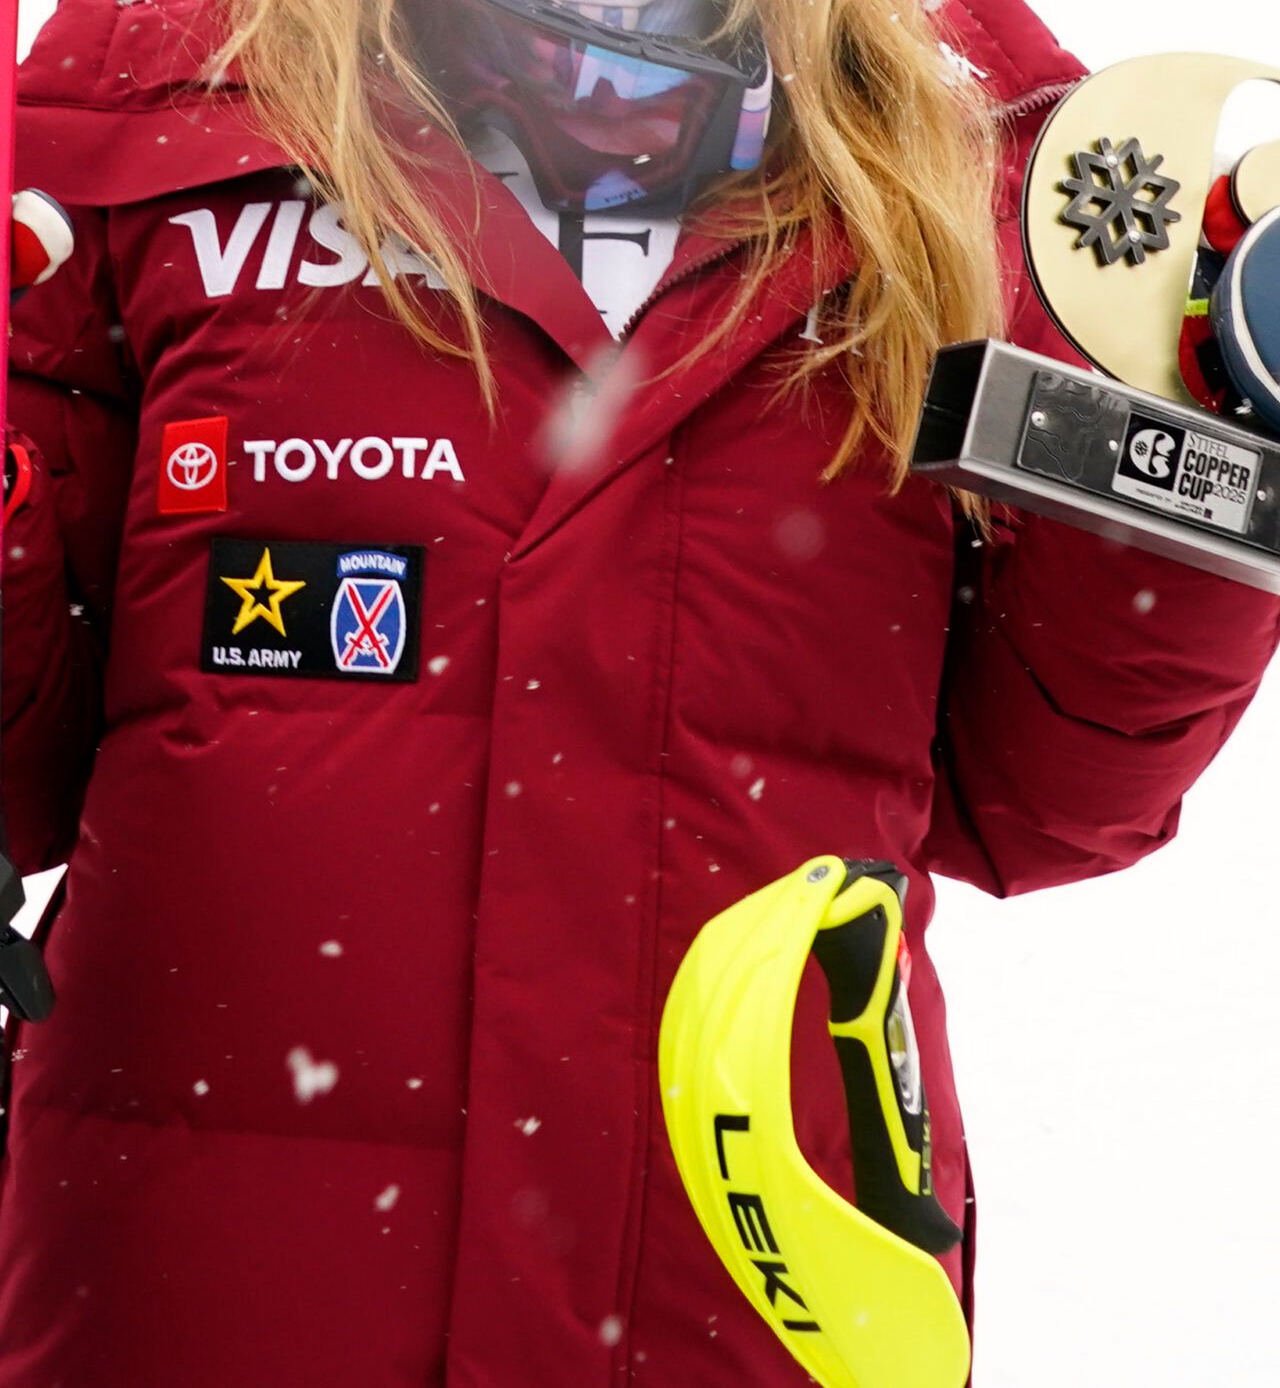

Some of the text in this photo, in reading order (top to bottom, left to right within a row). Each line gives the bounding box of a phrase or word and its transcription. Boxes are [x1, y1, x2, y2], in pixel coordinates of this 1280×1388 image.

[243, 436, 466, 483] TOYOTA
[1186, 432, 1230, 461] STIFEL
[1183, 449, 1251, 491] COPPER
[1177, 472, 1214, 503] CUP
[1212, 483, 1247, 505] 2025
[338, 553, 408, 575] MOUNTAIN
[212, 646, 303, 670] U.S. ARMY
[713, 1113, 822, 1333] LEKI
